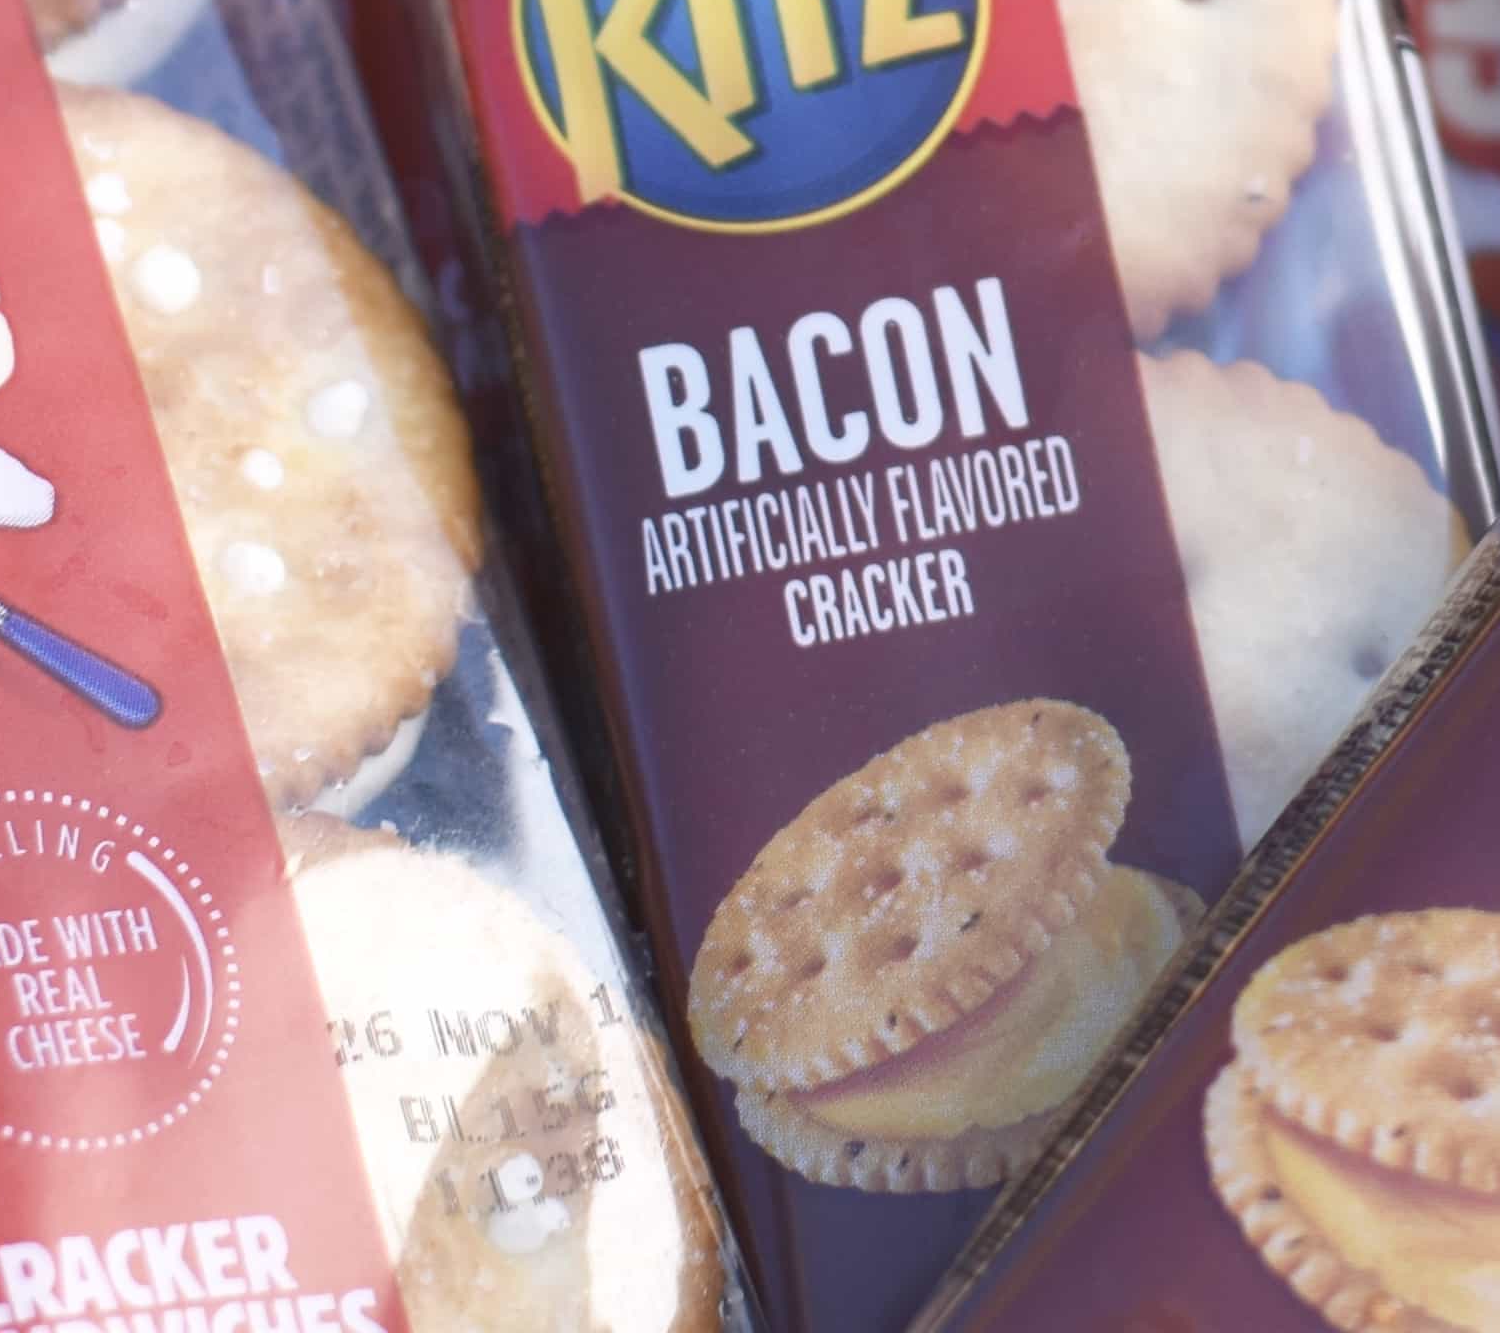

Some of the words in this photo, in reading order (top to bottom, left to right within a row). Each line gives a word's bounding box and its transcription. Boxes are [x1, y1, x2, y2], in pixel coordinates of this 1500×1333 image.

[638, 276, 1030, 500] BACON
[641, 474, 877, 596] ARTIFICIALLY
[886, 434, 1081, 544] FLAVORED
[783, 548, 975, 649] CRACKER
[57, 907, 159, 962] WITH
[15, 967, 113, 1017] REAL
[7, 1013, 148, 1073] CHEESE
[432, 998, 563, 1058] NOV
